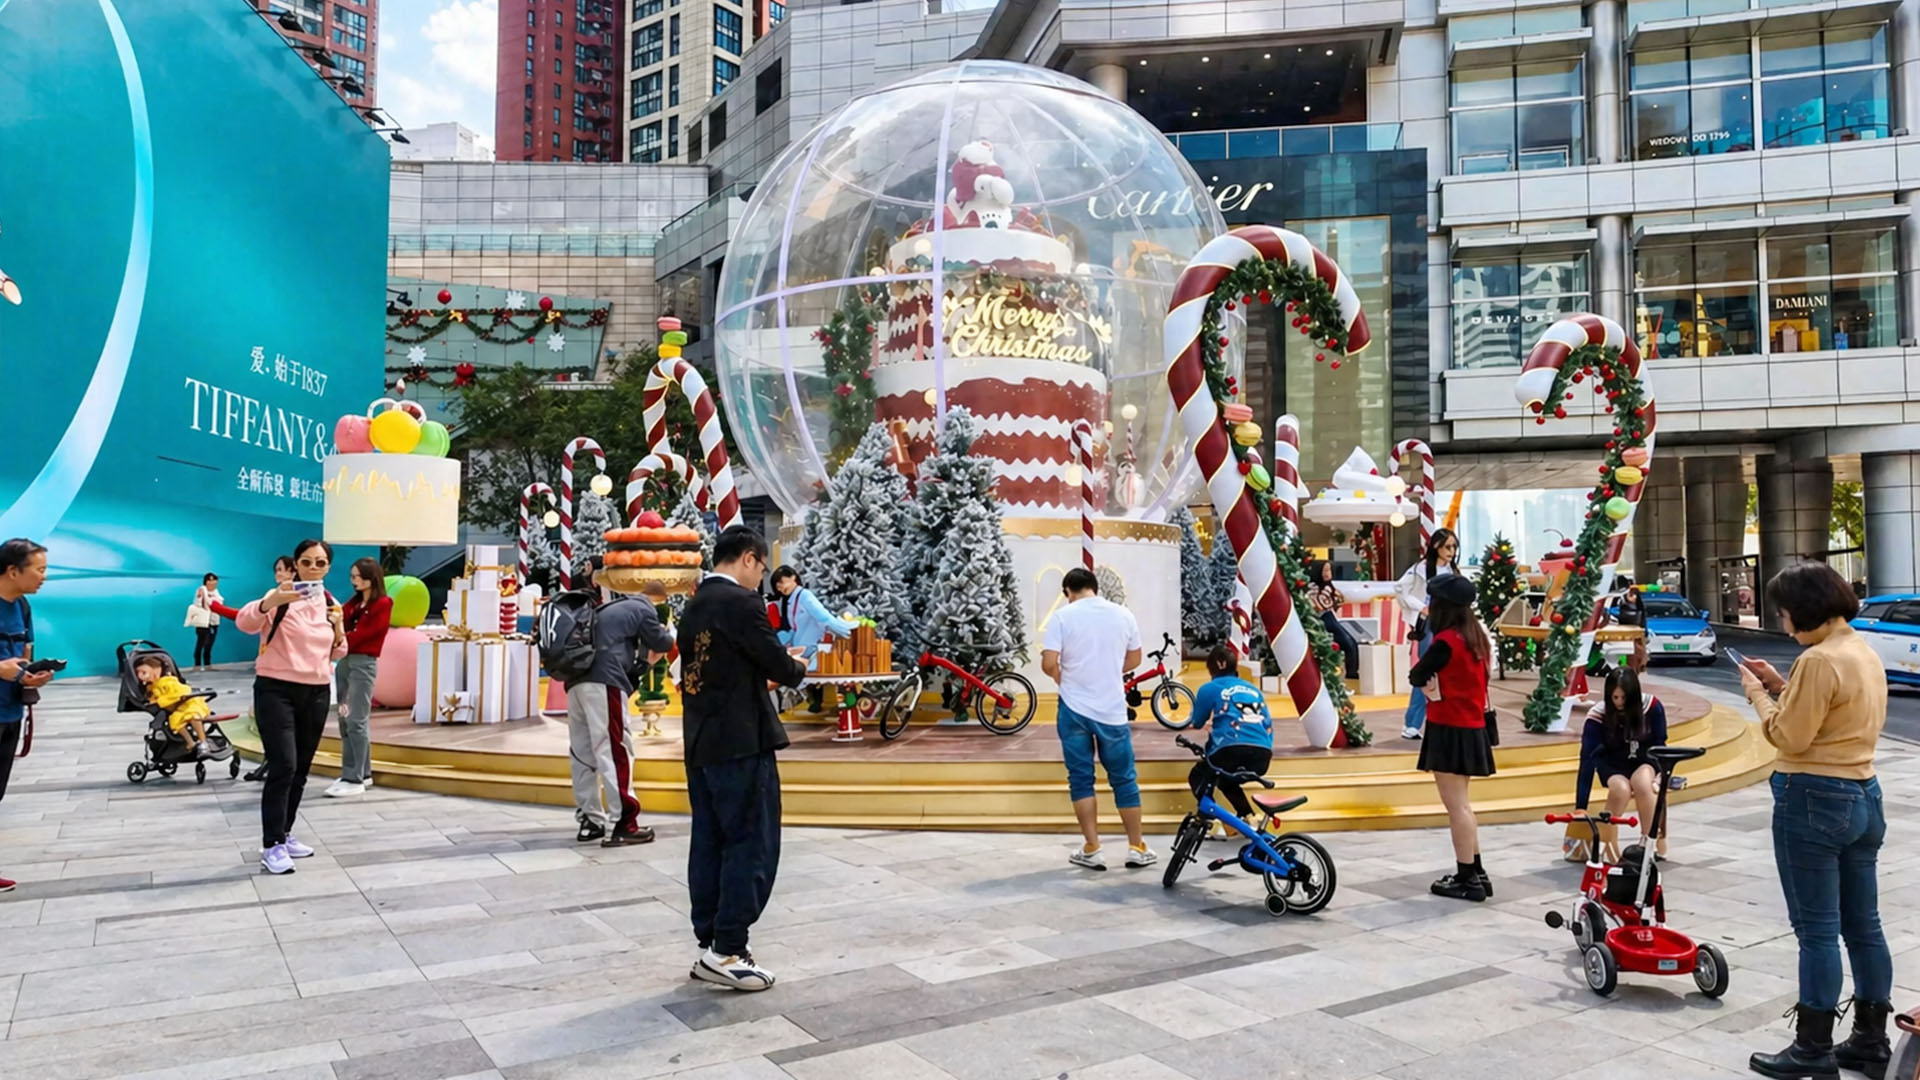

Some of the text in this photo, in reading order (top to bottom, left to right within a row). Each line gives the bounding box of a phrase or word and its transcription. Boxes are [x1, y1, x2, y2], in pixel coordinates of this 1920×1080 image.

[963, 291, 1065, 339] Merry
[1775, 294, 1828, 310] DAMIANI
[951, 323, 1093, 363] Christmas
